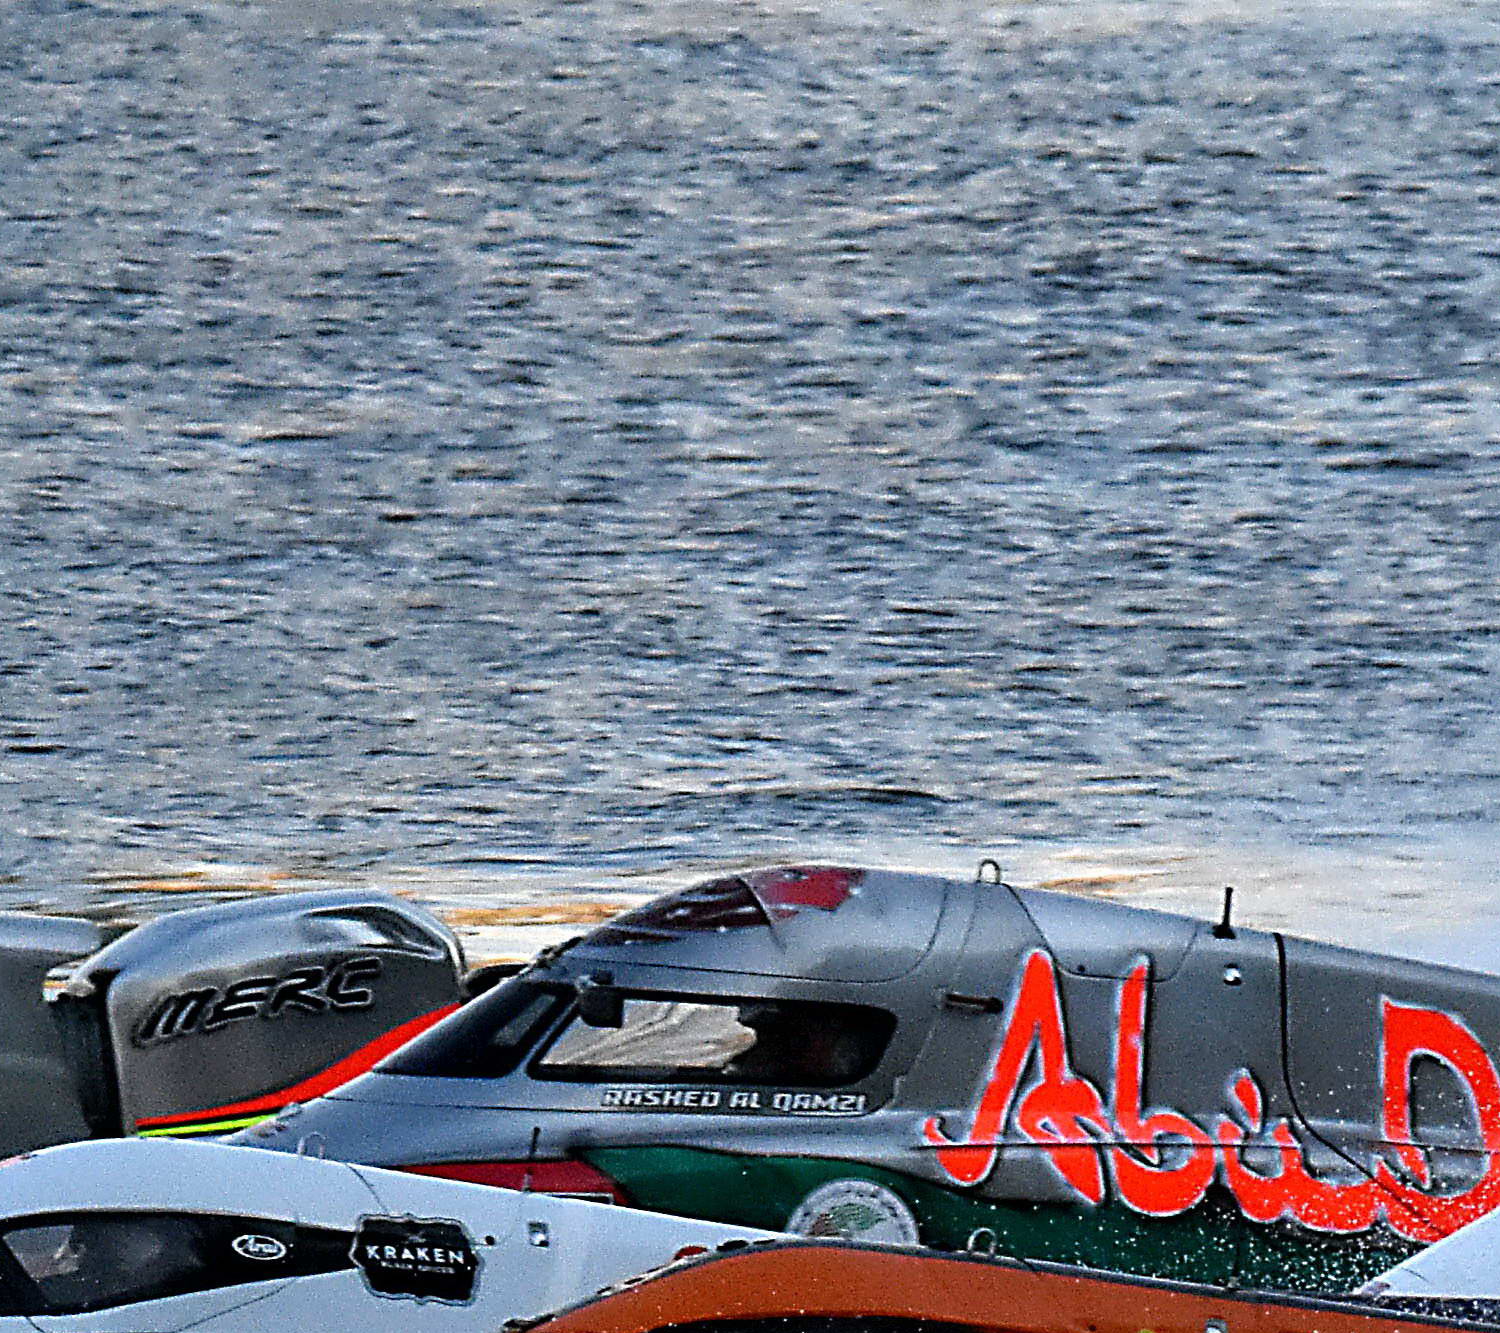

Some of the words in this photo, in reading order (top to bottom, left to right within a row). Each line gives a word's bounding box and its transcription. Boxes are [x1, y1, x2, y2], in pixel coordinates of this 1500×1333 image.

[132, 956, 384, 1050] MERC
[604, 1090, 718, 1108] RASHED
[728, 1090, 761, 1110] AL
[773, 1092, 866, 1112] QAMZI
[922, 948, 1308, 1232] Abu
[365, 1244, 465, 1265] KRAKEN
